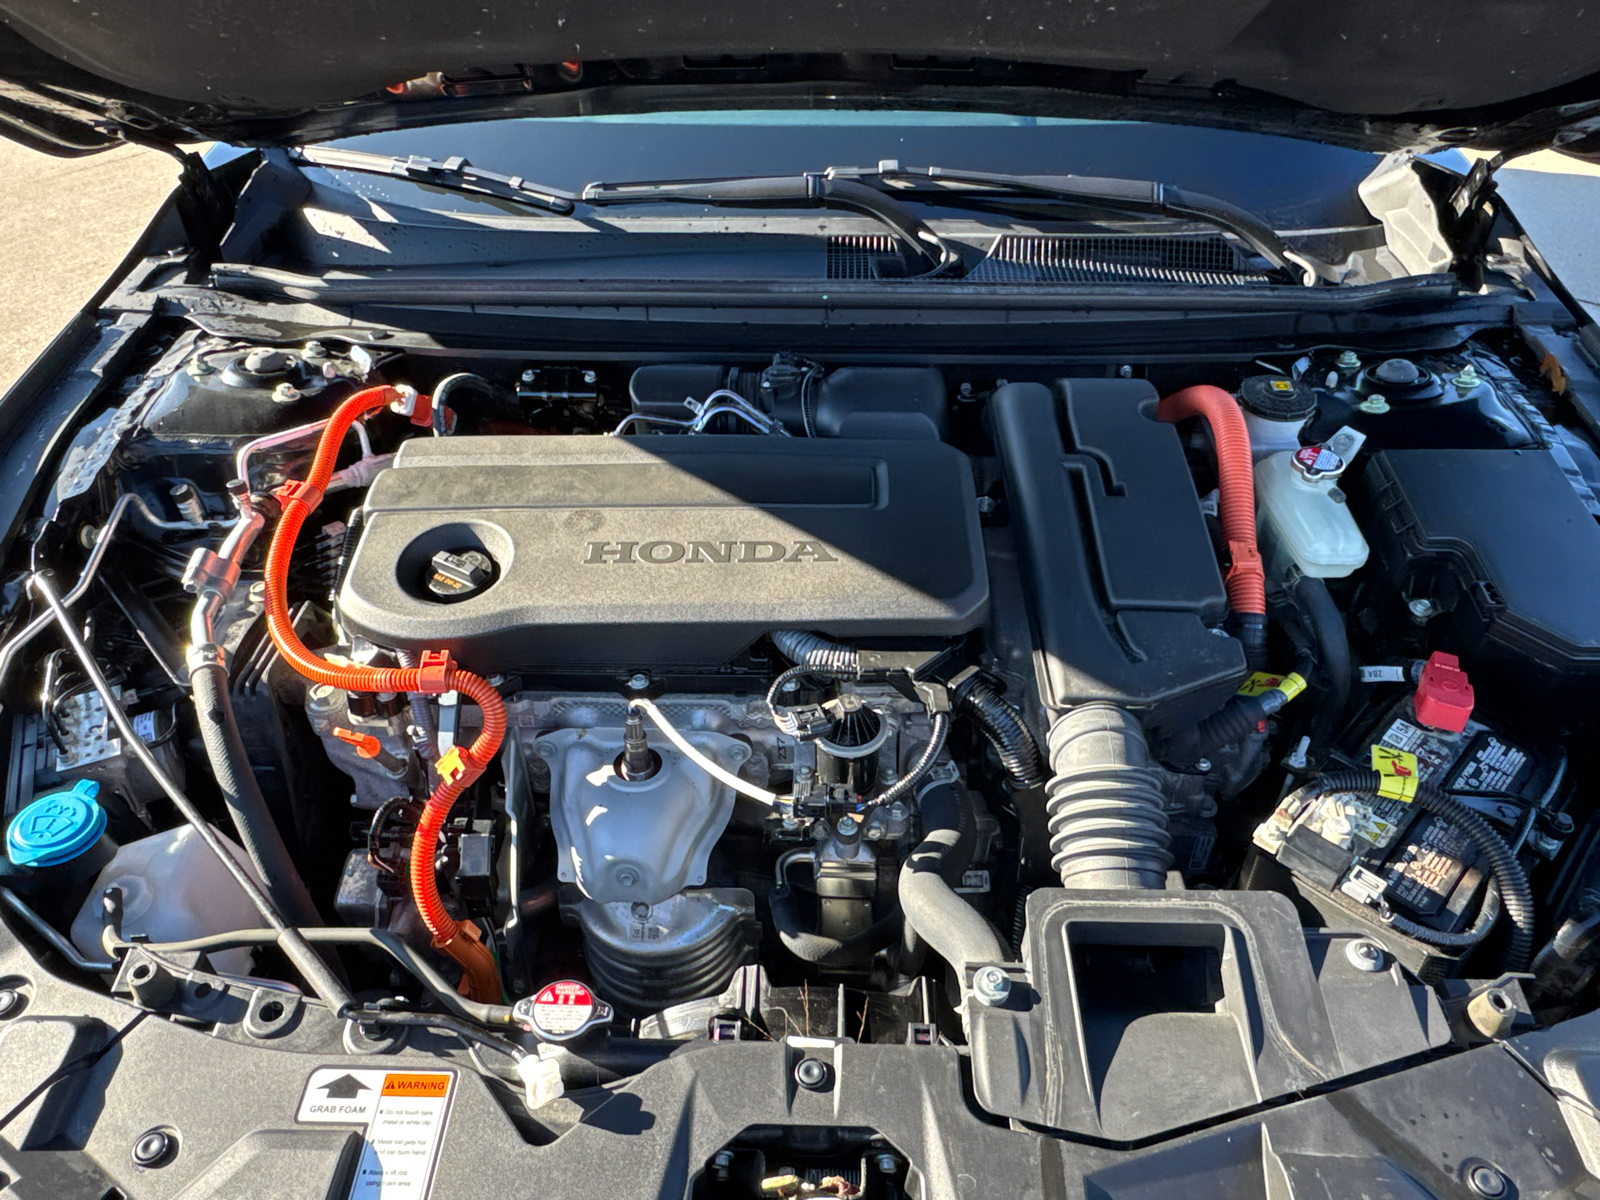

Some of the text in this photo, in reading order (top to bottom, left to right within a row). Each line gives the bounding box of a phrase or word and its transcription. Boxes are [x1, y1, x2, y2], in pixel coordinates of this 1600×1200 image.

[583, 541, 838, 564] HONDA
[776, 737, 787, 760] 237
[397, 1081, 446, 1091] WARNING
[309, 1105, 367, 1114] GRAB FOAM
